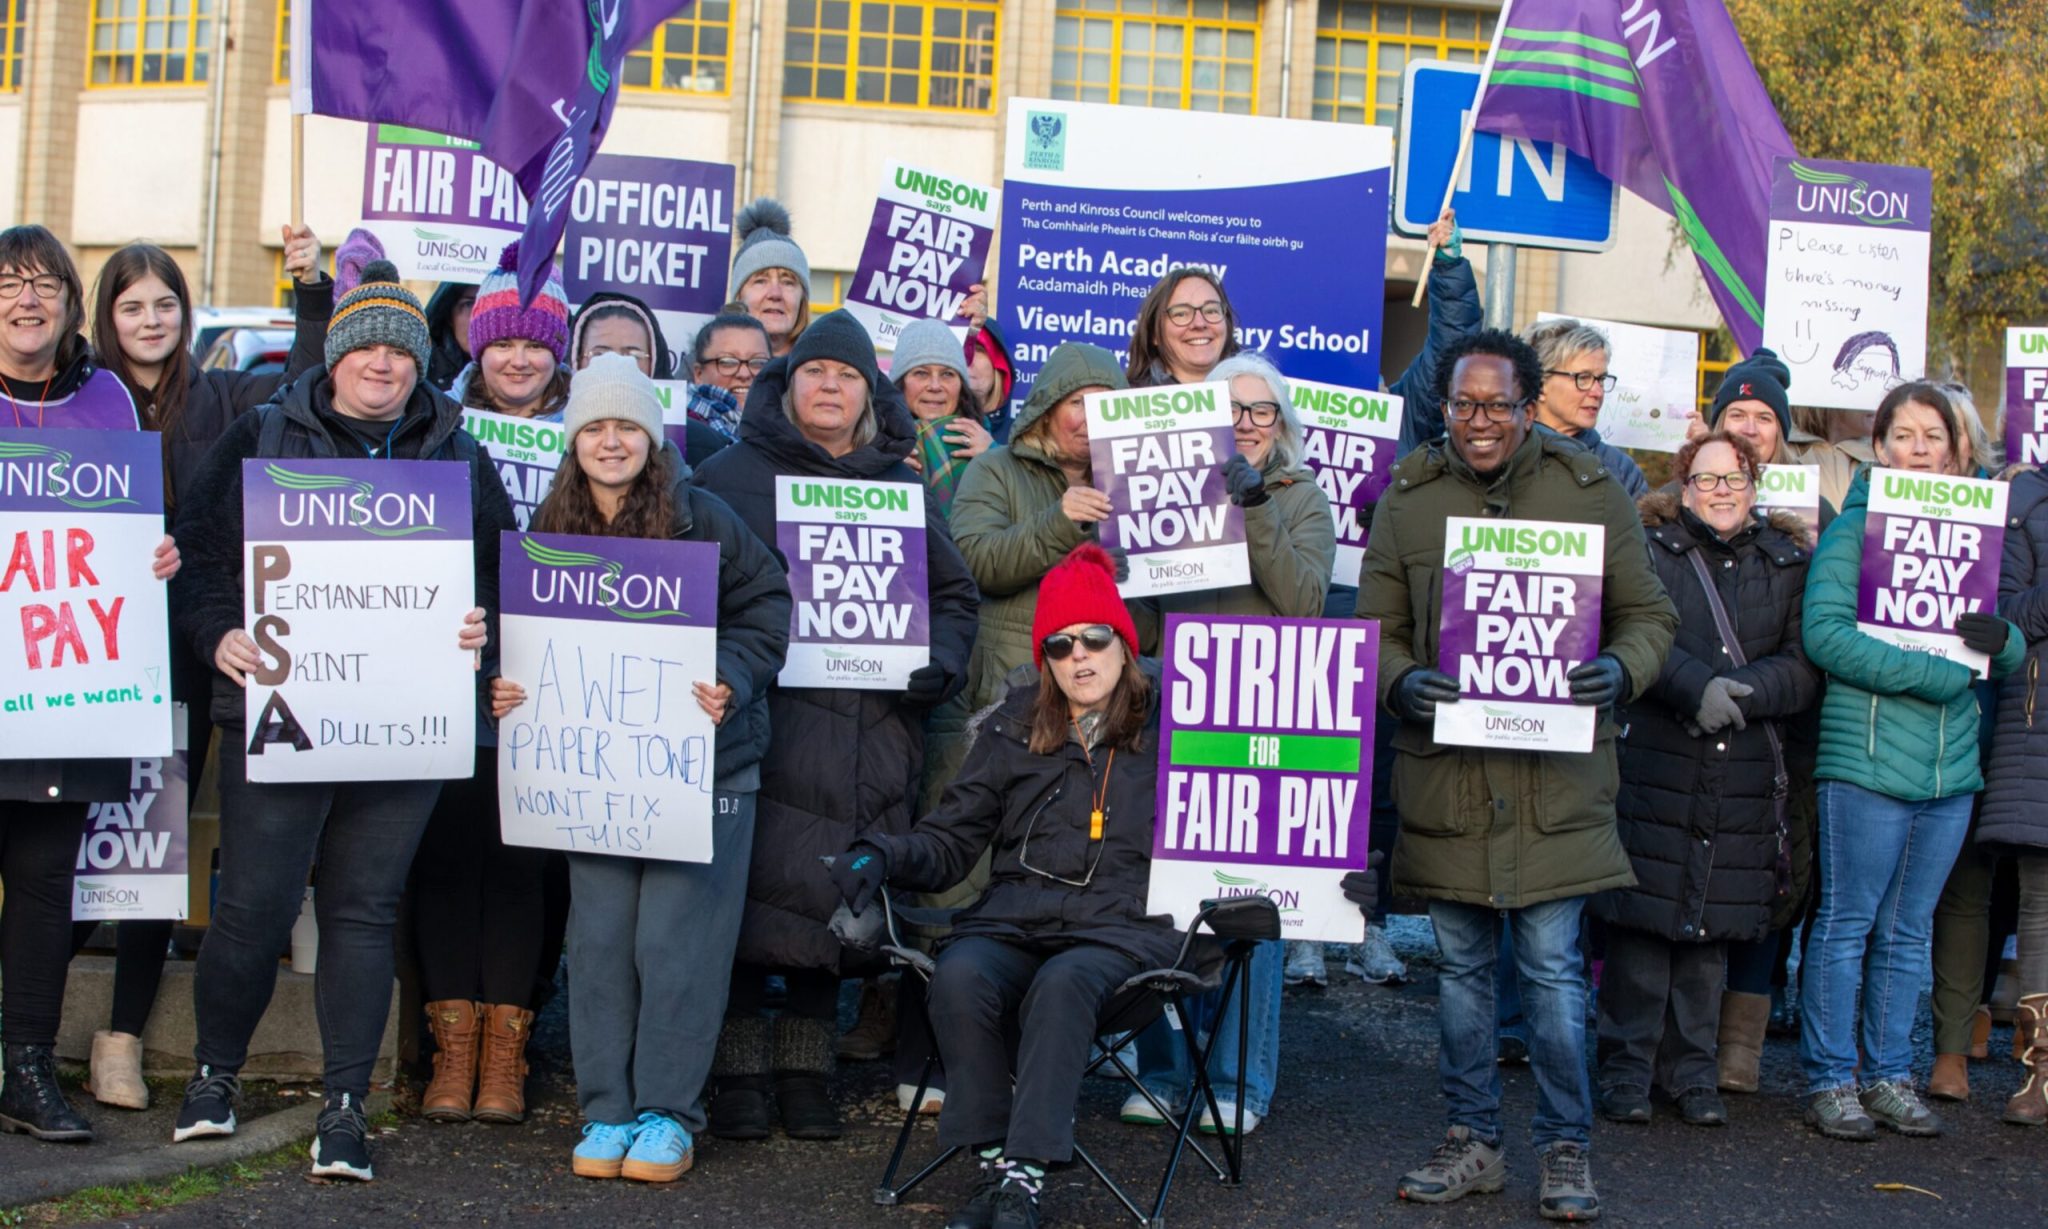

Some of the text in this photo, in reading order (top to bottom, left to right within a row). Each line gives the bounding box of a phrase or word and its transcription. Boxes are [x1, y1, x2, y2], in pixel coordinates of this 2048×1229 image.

[1456, 110, 1567, 202] IN
[371, 147, 457, 215] FAIR
[895, 166, 988, 213] UNISON
[570, 177, 730, 234] OFFICIAL
[926, 199, 952, 213] says
[1021, 198, 1262, 228] Perth and Kinross Council welcomes you to
[1797, 184, 1908, 218] UNISON
[886, 204, 975, 258] FAIR
[1022, 217, 1040, 229] Tha
[1101, 223, 1136, 236] Pheairt
[1138, 226, 1147, 237] is
[1148, 227, 1186, 240] Cheann
[1188, 230, 1208, 242] Rois
[1262, 236, 1288, 248] oirbh
[1290, 239, 1304, 251] gu
[1779, 227, 1849, 256] Please
[417, 240, 488, 261] UNISON
[578, 237, 708, 288] PICKET
[888, 240, 964, 287] PAY
[1017, 244, 1093, 273] Perth
[865, 270, 967, 322] NOW
[1017, 275, 1108, 296] Acadamaidh
[1842, 278, 1902, 301] money
[878, 321, 903, 338] UNI
[1278, 324, 1369, 354] School
[1100, 389, 1216, 422] UNISON
[1144, 417, 1177, 430] says
[1317, 414, 1348, 428] says
[466, 415, 568, 455] UNISO
[1111, 431, 1216, 475] FAIR
[1302, 428, 1377, 473] AIR
[505, 448, 537, 461] says
[791, 483, 909, 512] UNISON
[1127, 468, 1211, 512] PAY
[1314, 466, 1367, 505] AY
[1883, 475, 1994, 510] UNISON
[278, 492, 435, 527] UNISON
[834, 510, 868, 522] says
[1117, 503, 1228, 550] NOW
[1921, 504, 1952, 517] says
[799, 525, 905, 564] FAIR
[1462, 525, 1587, 557] UNISON
[1883, 516, 1982, 560] FAIR
[0, 527, 101, 593] AIR
[1149, 562, 1204, 580] UNISON
[1505, 555, 1540, 569] says
[1891, 553, 1973, 595] PAY
[531, 568, 682, 611] UNISON
[812, 563, 899, 601] PAY
[1464, 572, 1577, 616] FAIR
[798, 601, 913, 640] NOW
[1874, 587, 1982, 630] NOW
[20, 596, 125, 670] PAY
[1475, 614, 1569, 657] PAY
[534, 638, 684, 727] A WET
[826, 658, 883, 673] UNISON
[1171, 621, 1367, 732] STRIKE
[1458, 654, 1582, 699] NOW
[4, 692, 35, 712] all
[45, 692, 76, 708] we
[1485, 716, 1545, 733] UNISON
[506, 722, 713, 794] PAPER TOWEL
[1248, 736, 1280, 767] FOR
[86, 792, 157, 830] AY
[513, 784, 661, 821] WON'T FIX
[1163, 771, 1359, 859] FAIR PAY
[556, 823, 652, 852] THIS!
[80, 889, 139, 904] UNISON
